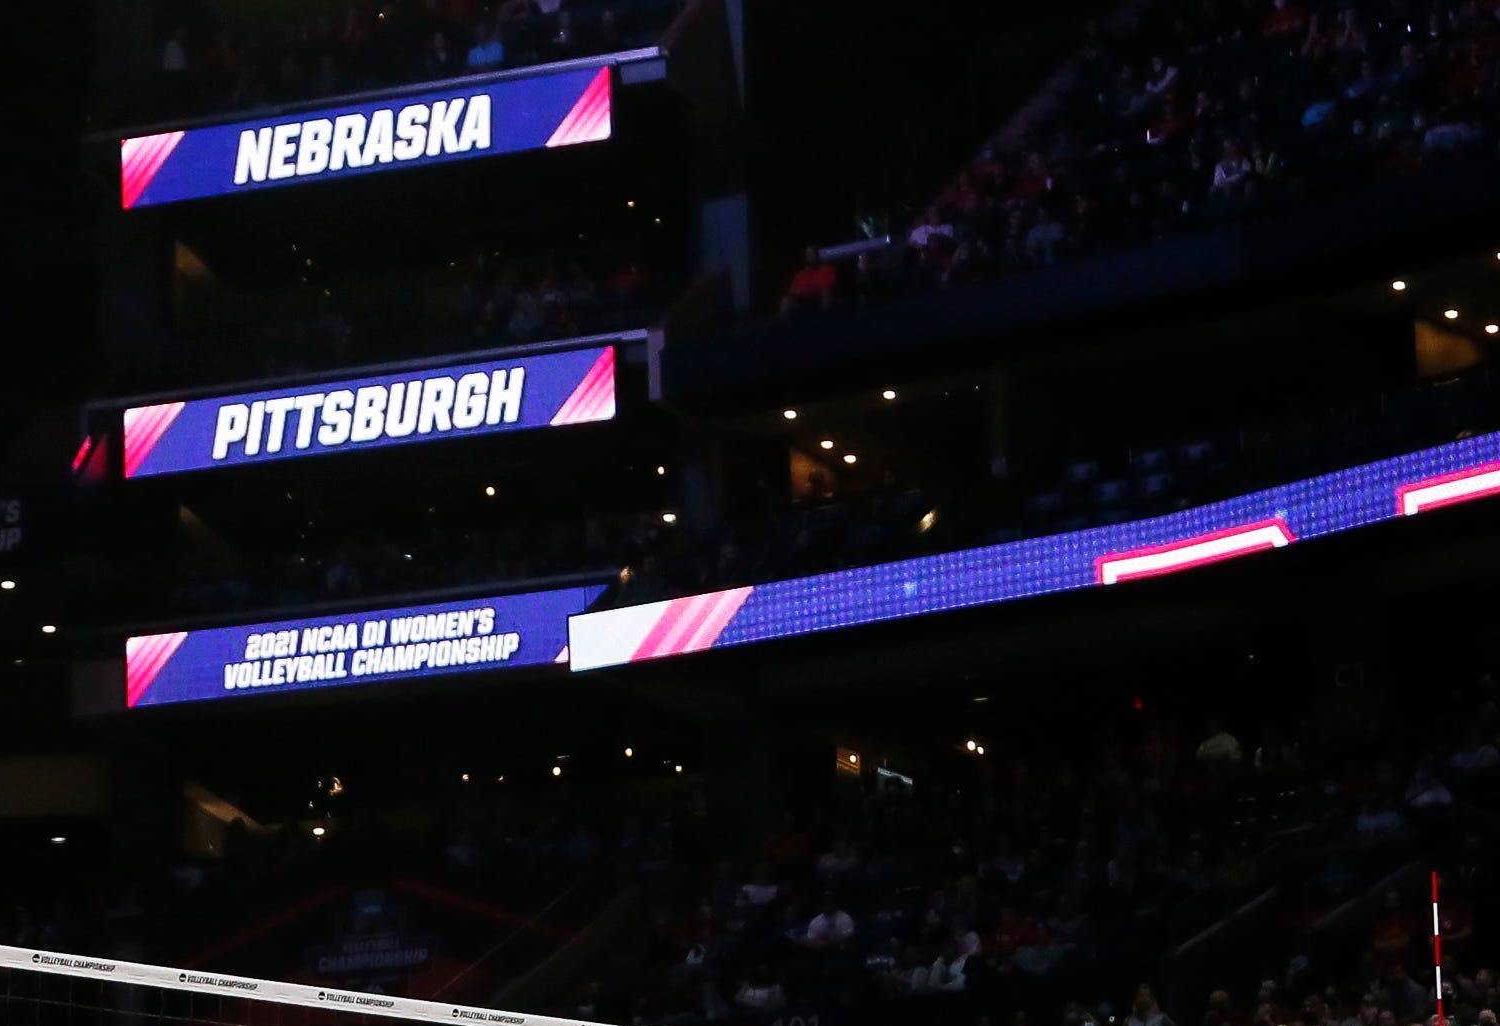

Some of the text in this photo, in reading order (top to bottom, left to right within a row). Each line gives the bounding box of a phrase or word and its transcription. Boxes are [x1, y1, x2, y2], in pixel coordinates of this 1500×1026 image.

[233, 94, 492, 185] NEBRASKA
[212, 367, 525, 460] PITTSBURGH
[224, 632, 520, 690] VOLLEYBALL CHAMPIONSHIP
[244, 606, 496, 660] 2021 NCAA DI WOMEN'S
[40, 956, 115, 972] VOLLEYBALL CHAMPIONSHIP
